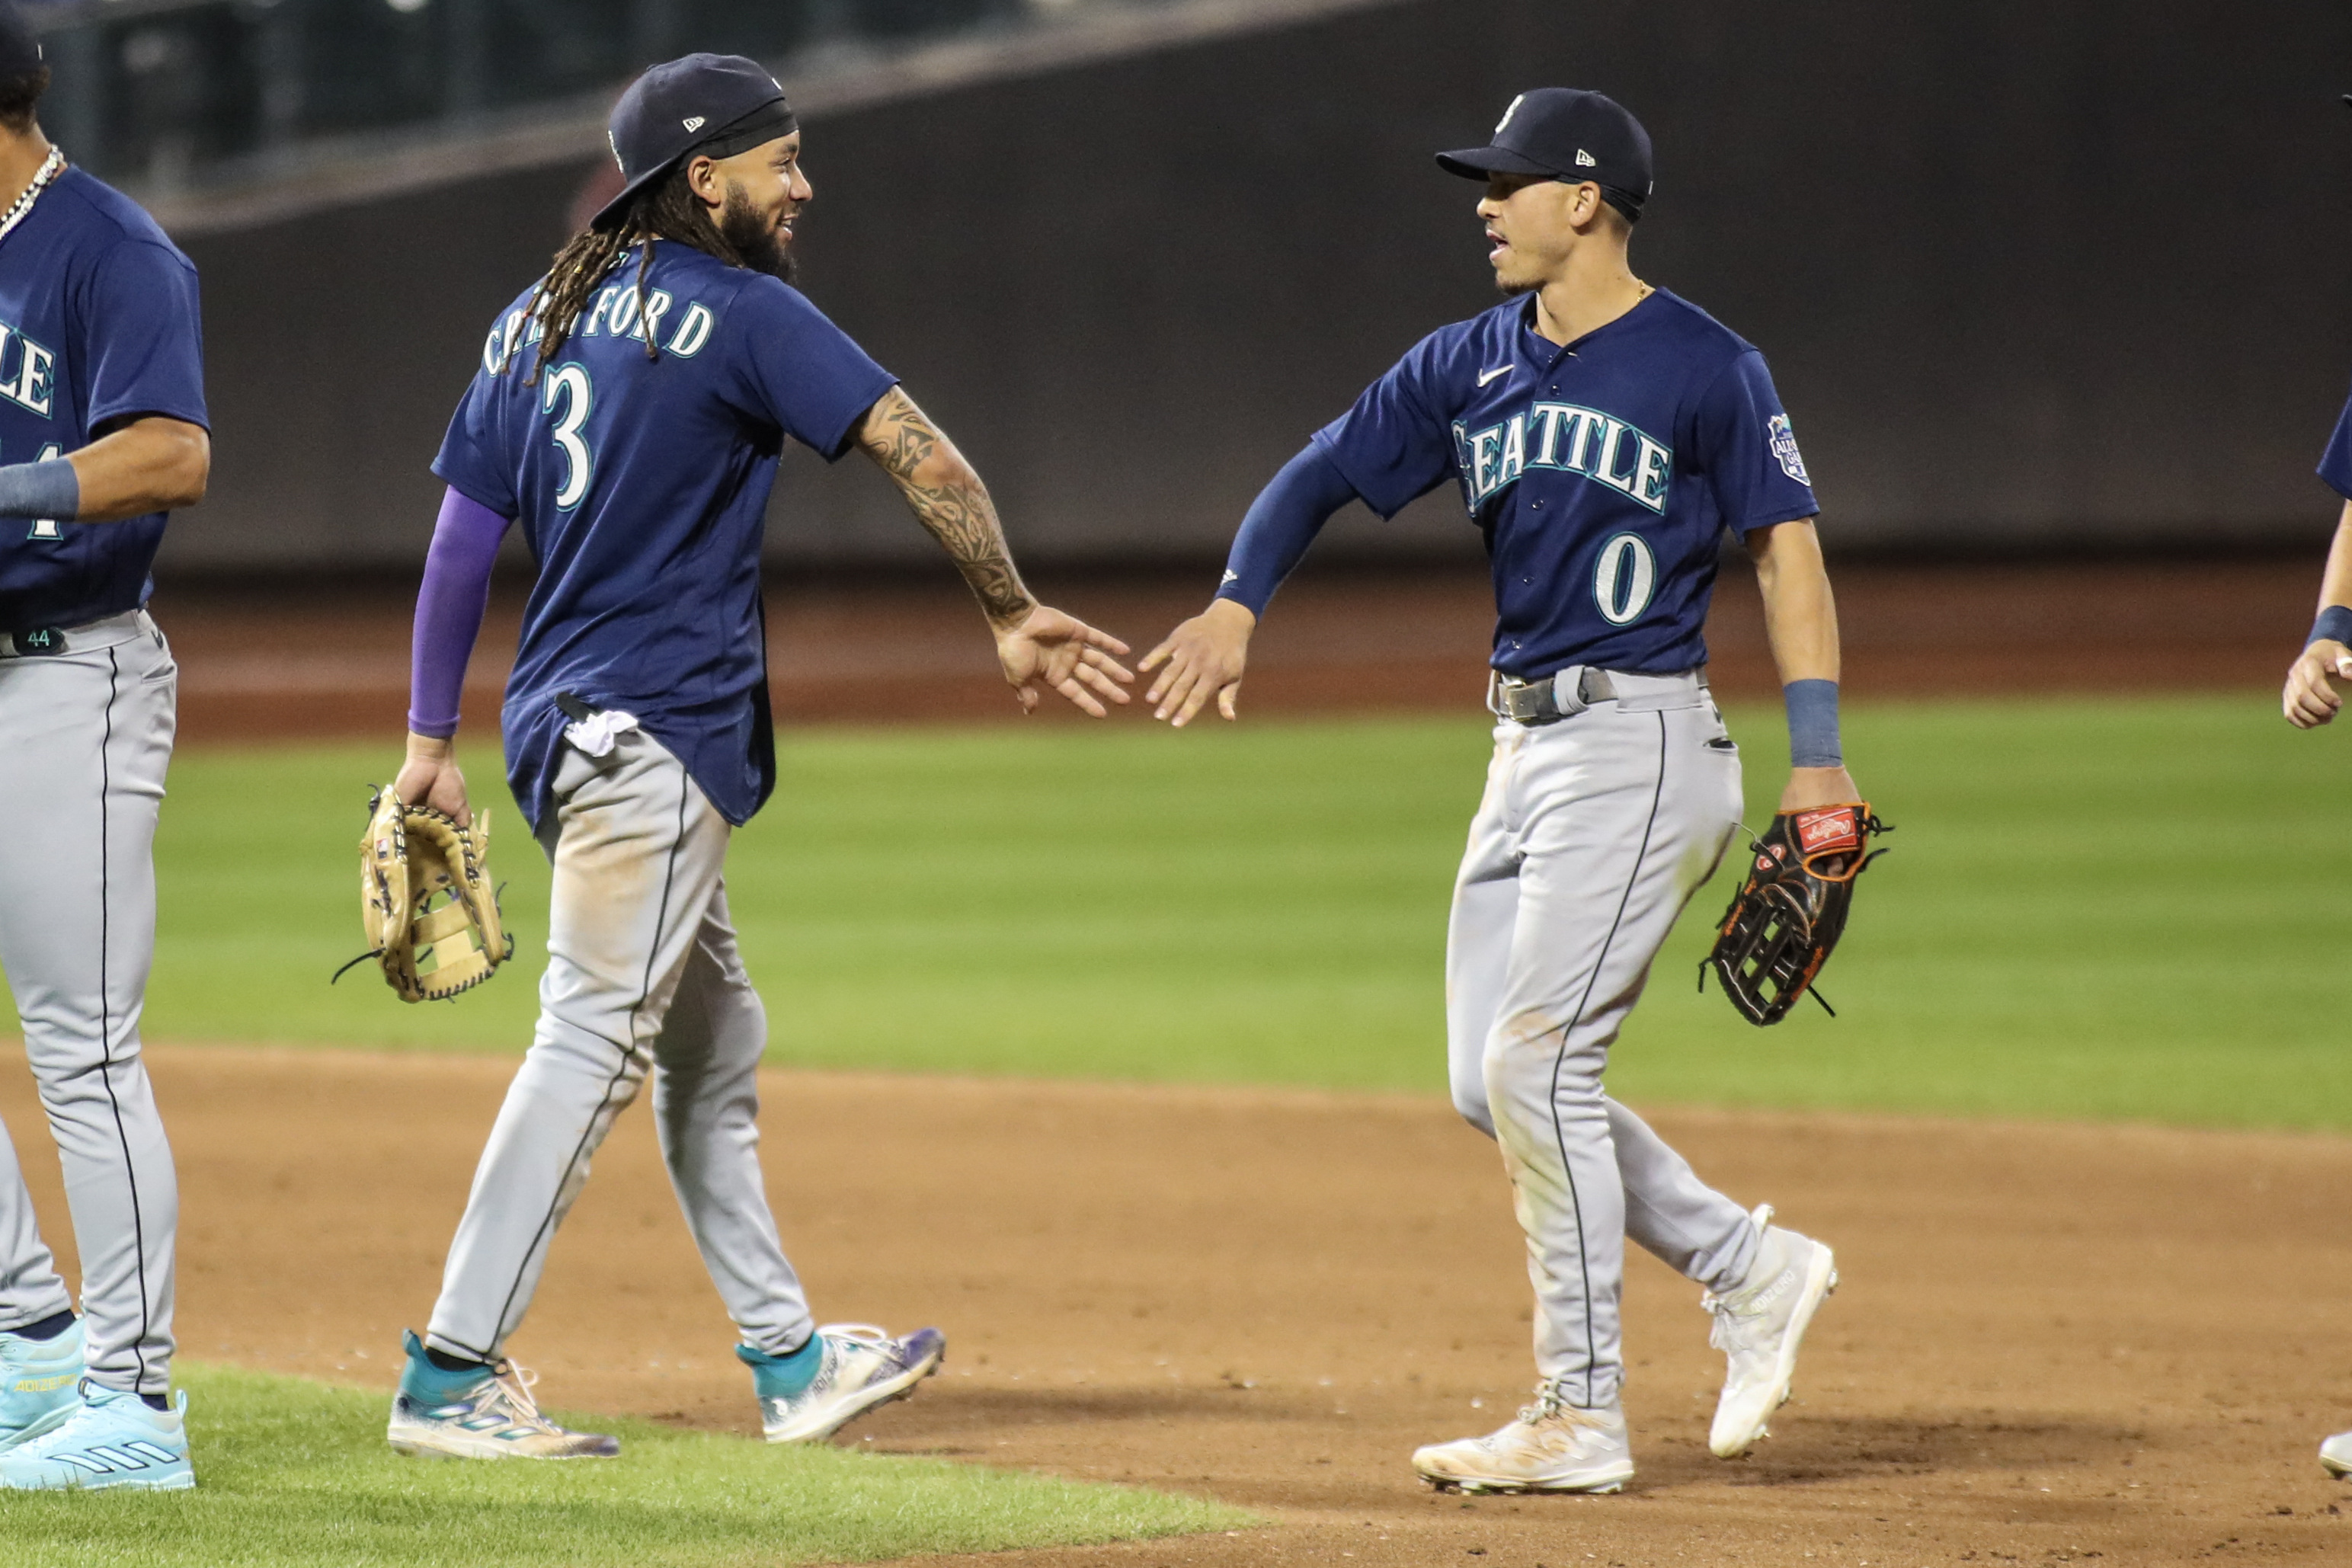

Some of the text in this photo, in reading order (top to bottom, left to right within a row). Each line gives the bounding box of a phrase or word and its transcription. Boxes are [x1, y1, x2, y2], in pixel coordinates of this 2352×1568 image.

[483, 284, 714, 377] CRAFORD
[542, 361, 594, 512] 3
[1451, 401, 1673, 517] SEATTLE
[1592, 532, 1657, 627] 0
[27, 629, 50, 648] 44
[14, 1373, 77, 1393] ADIZERO
